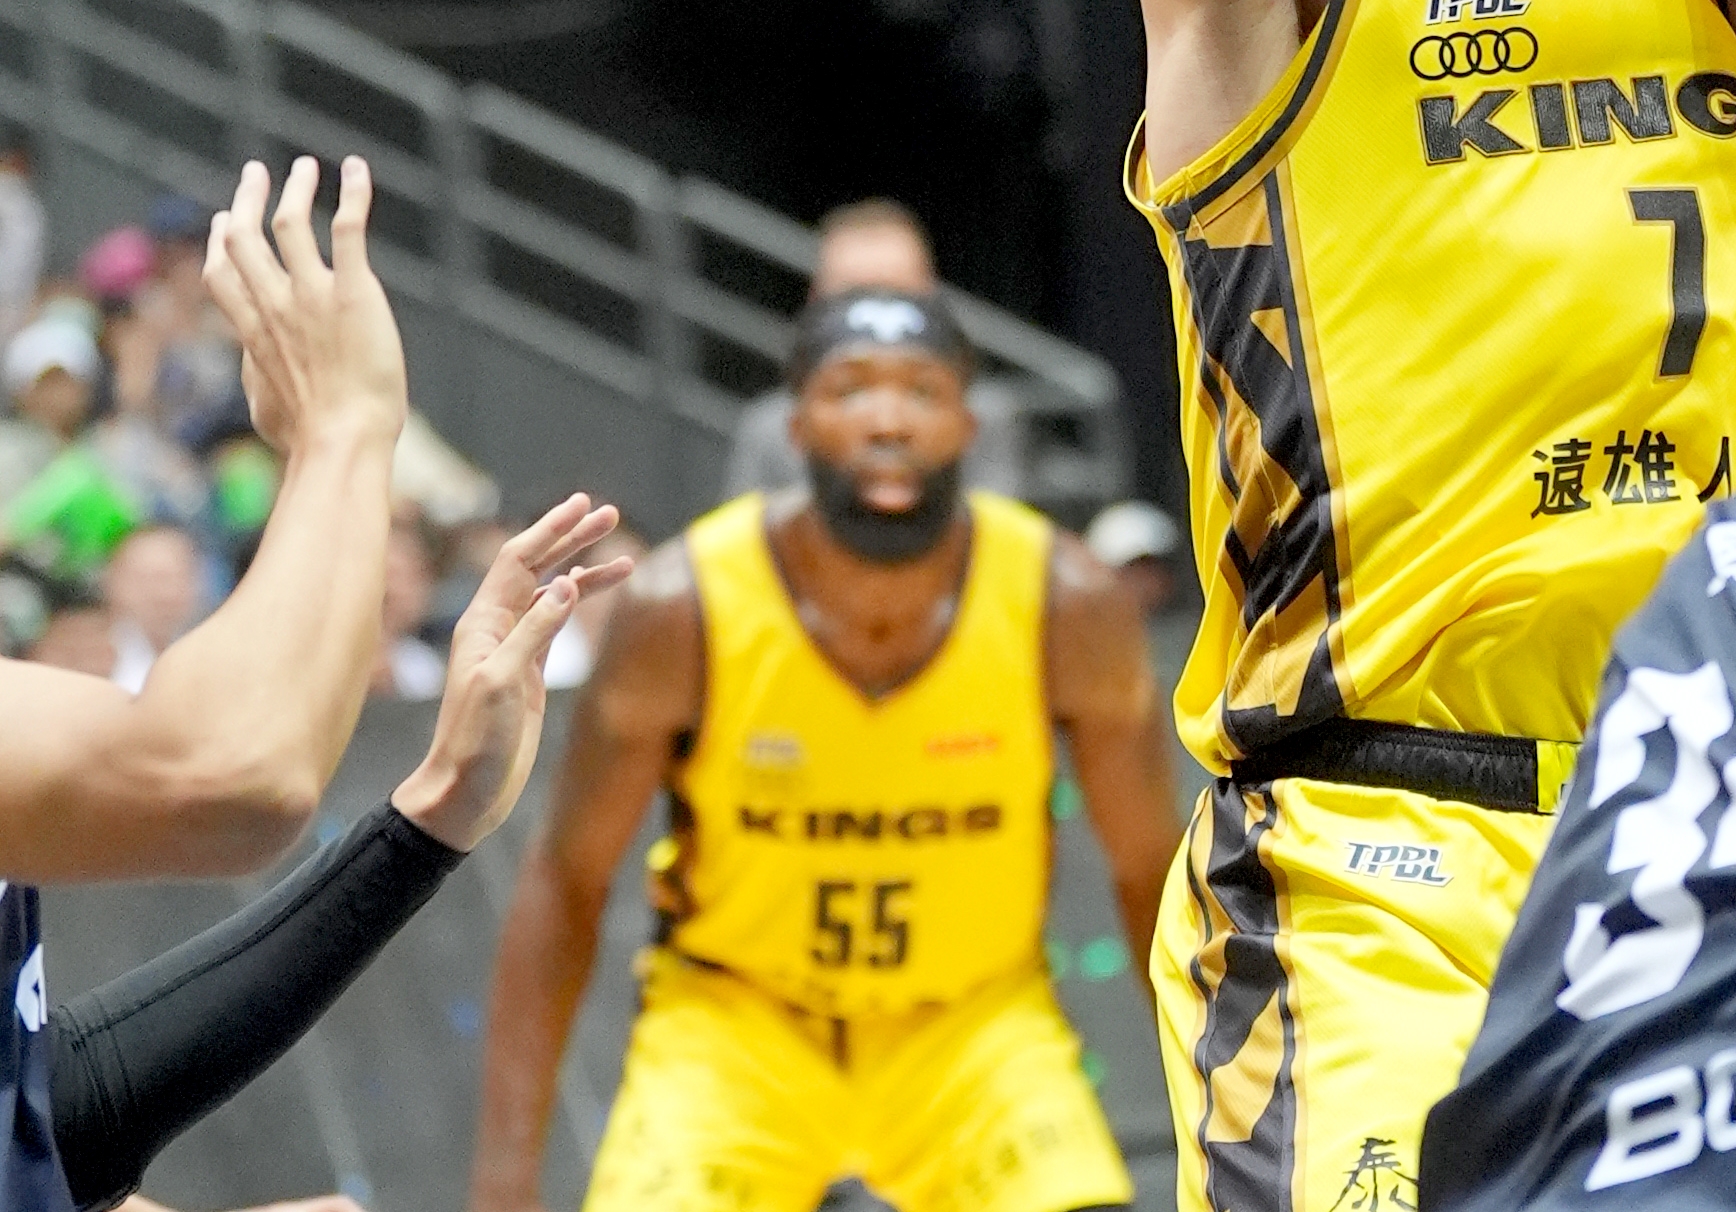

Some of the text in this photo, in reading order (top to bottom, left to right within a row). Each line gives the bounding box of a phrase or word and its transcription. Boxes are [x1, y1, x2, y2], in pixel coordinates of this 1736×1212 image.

[1623, 186, 1709, 384] 7
[1344, 841, 1455, 888] TPBL
[810, 880, 913, 972] 55
